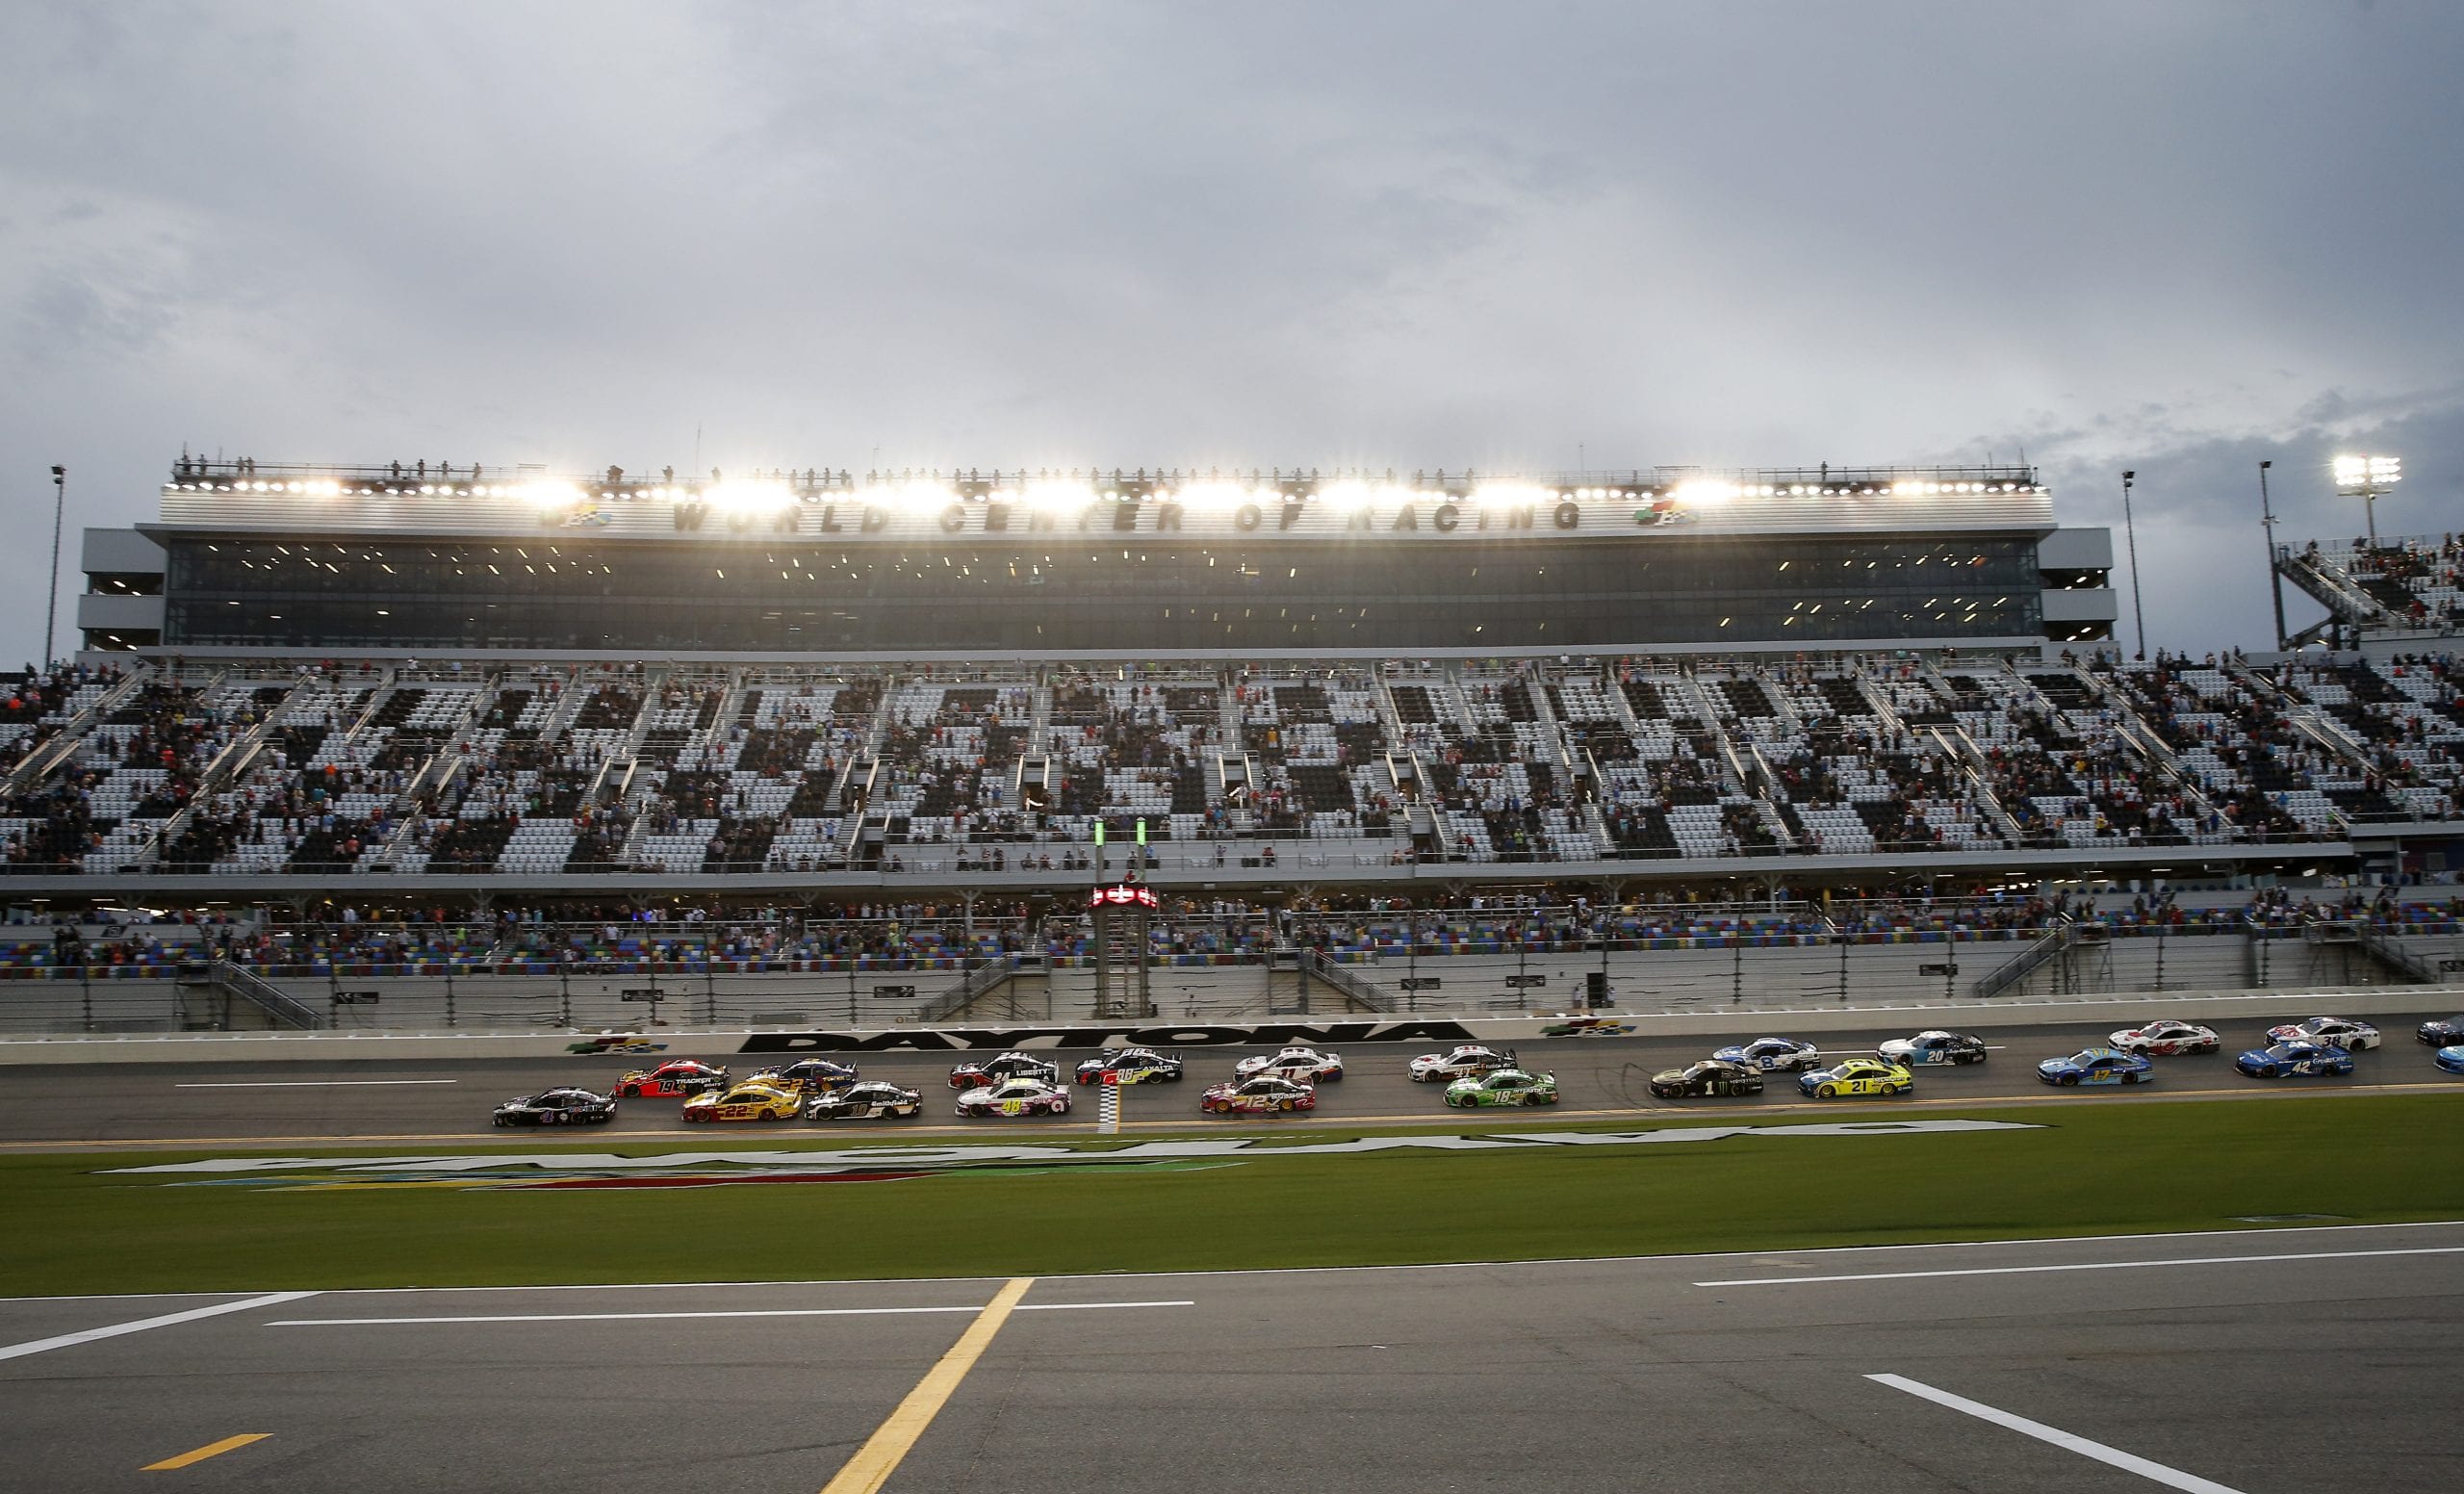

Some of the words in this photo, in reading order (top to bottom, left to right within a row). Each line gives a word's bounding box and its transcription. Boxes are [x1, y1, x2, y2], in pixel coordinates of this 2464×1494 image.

[674, 502, 889, 531] WORLD
[1235, 503, 1303, 530] OF
[1348, 502, 1579, 530] RACING
[737, 1021, 1476, 1052] DAYTONA
[2323, 1035, 2342, 1046] 38
[1759, 1055, 1775, 1069] 8
[1927, 1050, 1944, 1063] 20
[1015, 1069, 1049, 1077] LIBERTY
[1280, 1068, 1296, 1079] 11
[1453, 1067, 1472, 1078] 41
[2291, 1060, 2311, 1074] 42
[993, 1071, 1011, 1084] 24
[1116, 1068, 1135, 1081] 88
[2092, 1069, 2112, 1082] 17
[657, 1080, 674, 1094] 19
[789, 1078, 805, 1091] 2
[1705, 1080, 1714, 1095] 1
[1851, 1080, 1867, 1093] 21
[871, 1099, 909, 1108] Smithfield
[1245, 1095, 1269, 1109] 12
[1493, 1090, 1513, 1104] 18
[723, 1105, 748, 1118] 22
[850, 1103, 868, 1117] 10
[1002, 1099, 1022, 1114] 48
[539, 1110, 555, 1123] 4
[90, 1120, 2056, 1174] DAYTONA
